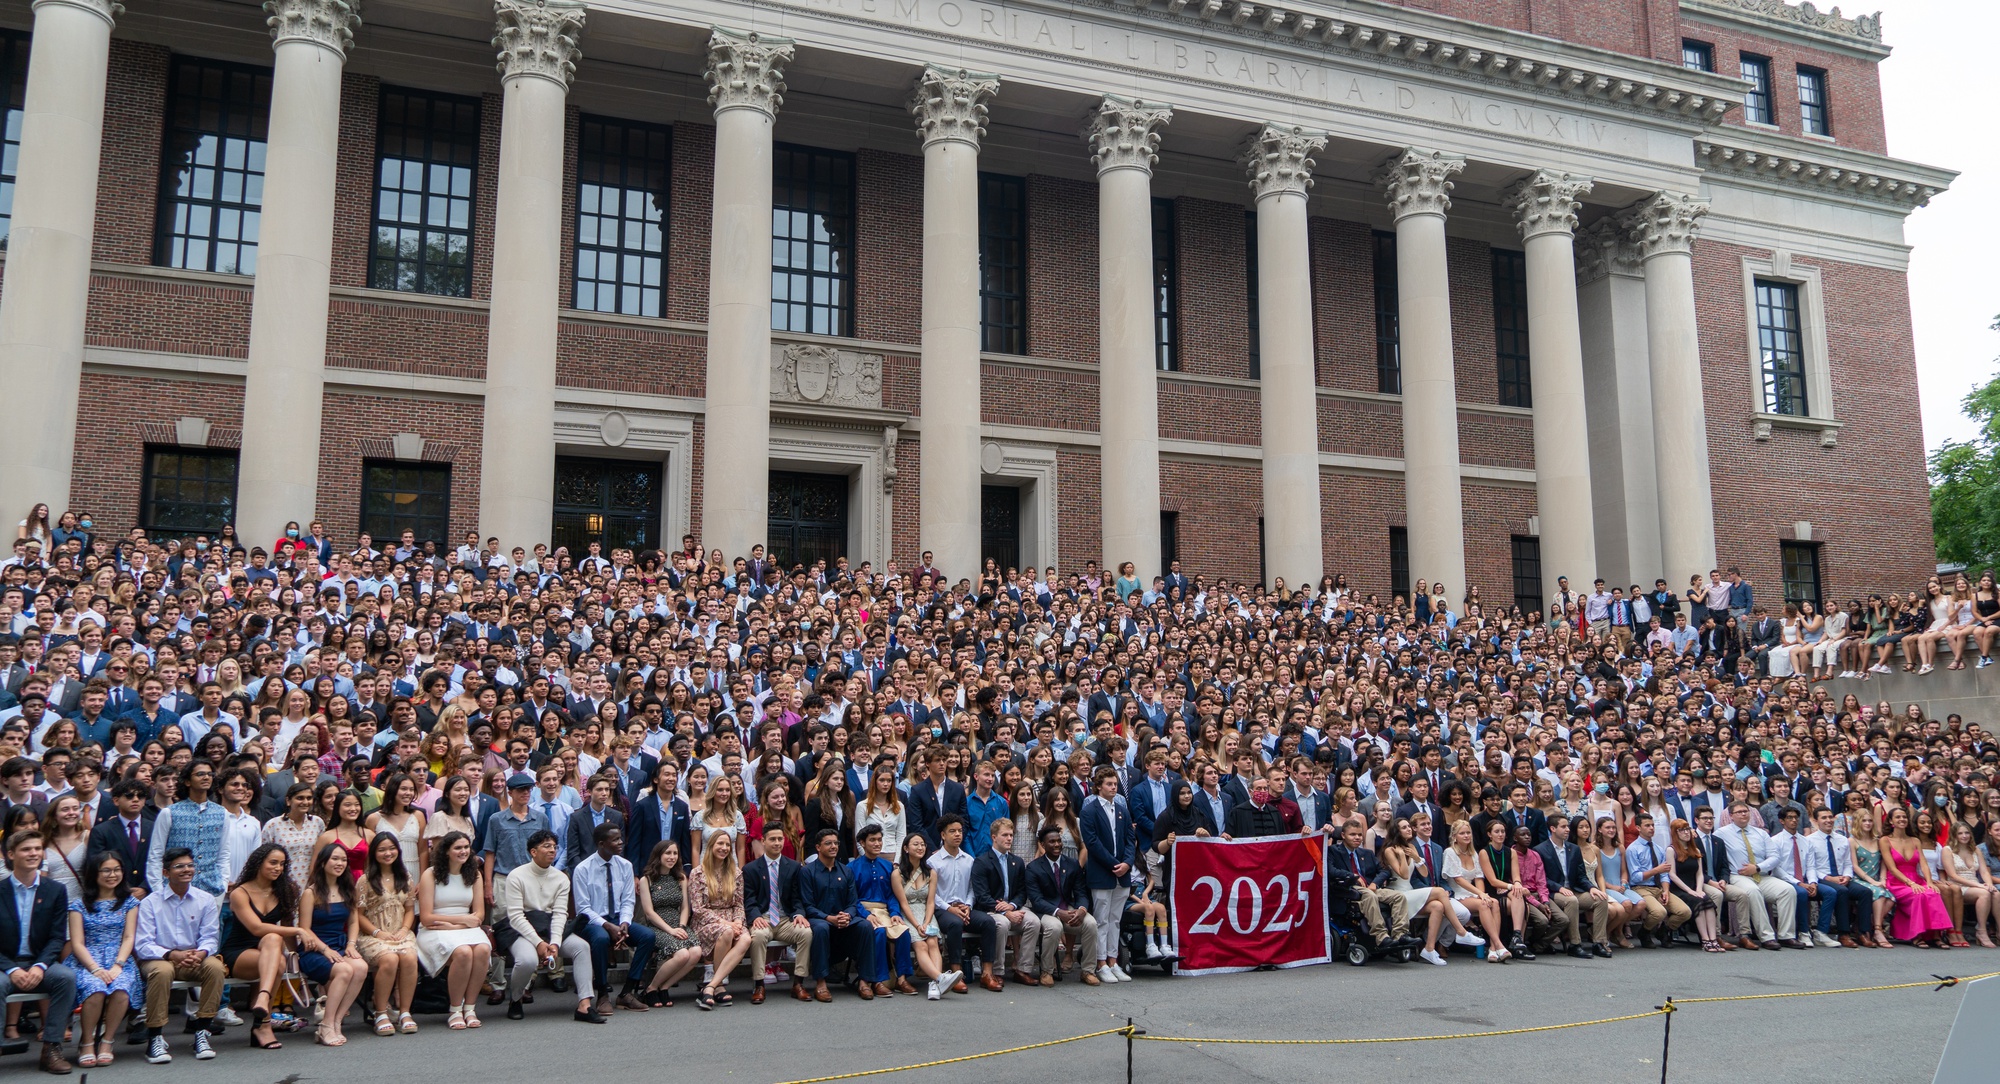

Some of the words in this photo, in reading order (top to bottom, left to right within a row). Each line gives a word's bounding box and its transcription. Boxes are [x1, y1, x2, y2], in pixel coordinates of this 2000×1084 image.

[1125, 35, 1310, 92] LIBRARY
[1451, 96, 1606, 143] MCMXIV
[1188, 865, 1316, 935] 2025
